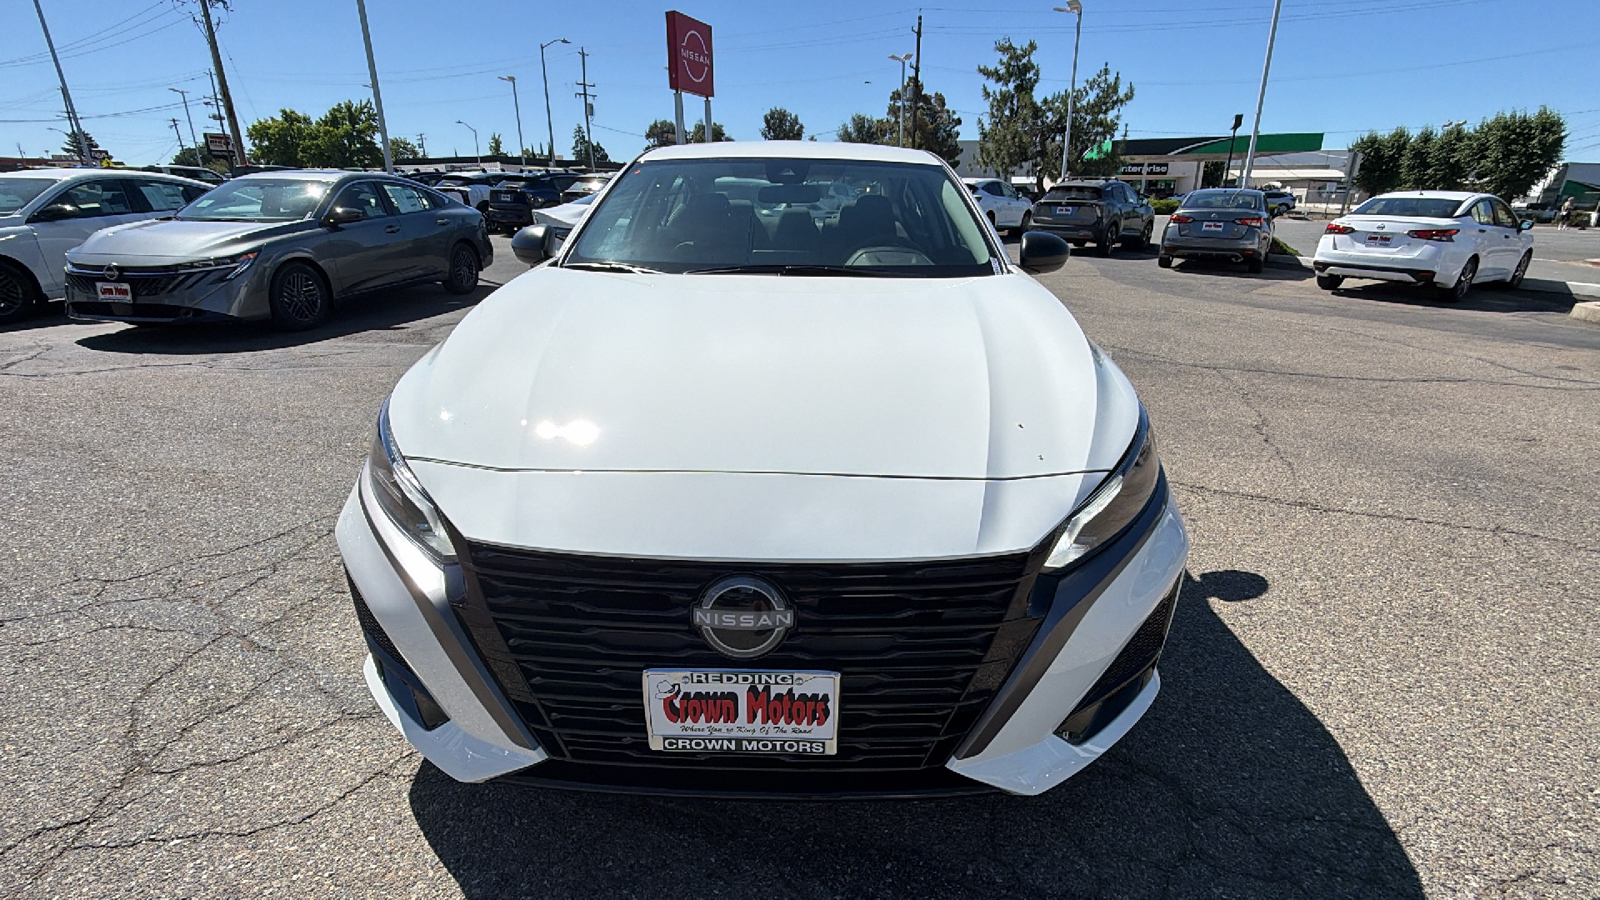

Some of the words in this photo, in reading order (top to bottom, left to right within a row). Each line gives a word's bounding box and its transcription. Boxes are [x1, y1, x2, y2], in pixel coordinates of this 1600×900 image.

[681, 48, 710, 65] NISSAN
[1118, 165, 1168, 174] nterrise
[696, 611, 791, 627] NISSAN
[692, 673, 793, 685] REDDING
[663, 683, 738, 724] Crown
[746, 685, 830, 726] Motors
[680, 725, 705, 733] Where
[736, 726, 756, 735] King
[759, 726, 770, 735] Of
[773, 726, 788, 734] The
[791, 727, 813, 735] Road
[664, 738, 736, 751] CROWN
[742, 740, 824, 753] MOTORS
